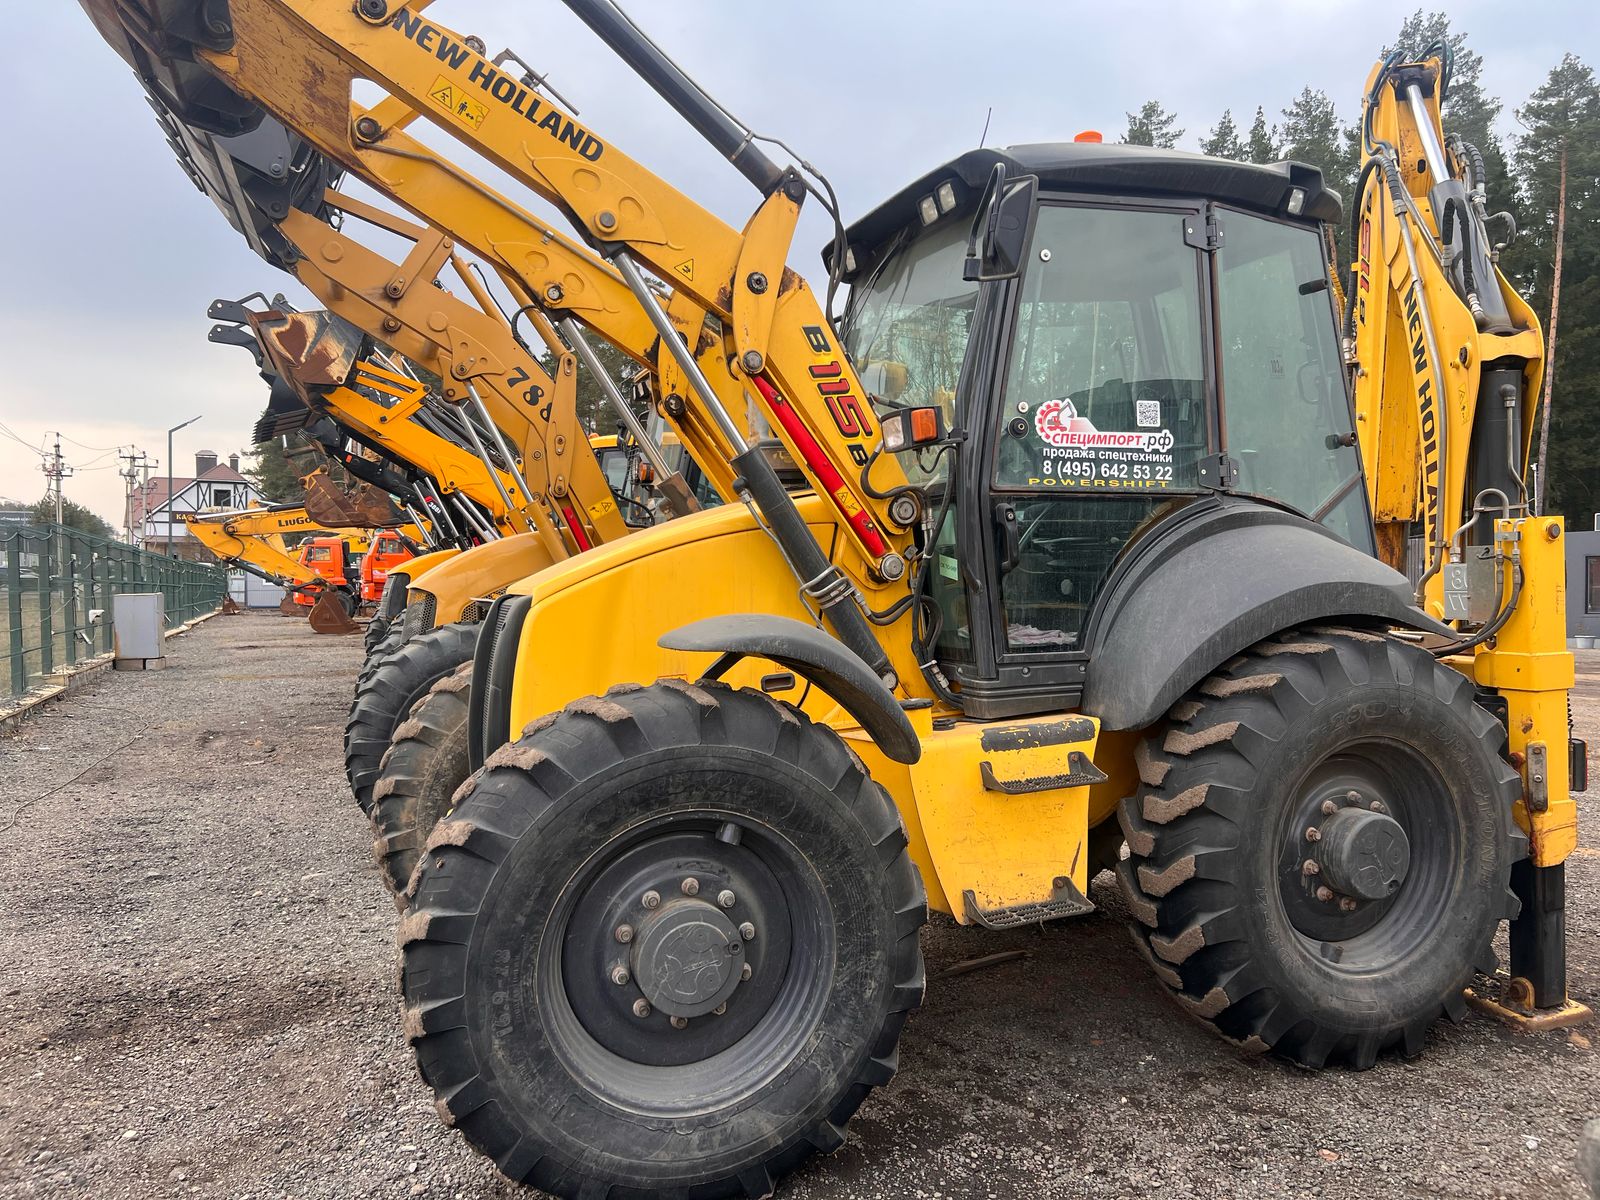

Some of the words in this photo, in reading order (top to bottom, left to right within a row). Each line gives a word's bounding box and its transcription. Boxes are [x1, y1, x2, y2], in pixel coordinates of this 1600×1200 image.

[392, 9, 470, 71] NEW
[468, 60, 604, 162] HOLLAND
[1404, 280, 1427, 375] NEW
[1418, 379, 1439, 567] HOLLAN
[1043, 448, 1095, 459] продажа
[1099, 450, 1173, 463] спецтехники
[1043, 460, 1052, 475] 8
[1057, 461, 1096, 480] (495)
[1101, 463, 1128, 478] 642
[1133, 465, 1150, 479] 53
[1155, 466, 1173, 480] 22
[1028, 478, 1170, 488] POWERSHIFT
[278, 516, 313, 527] LIUGO
